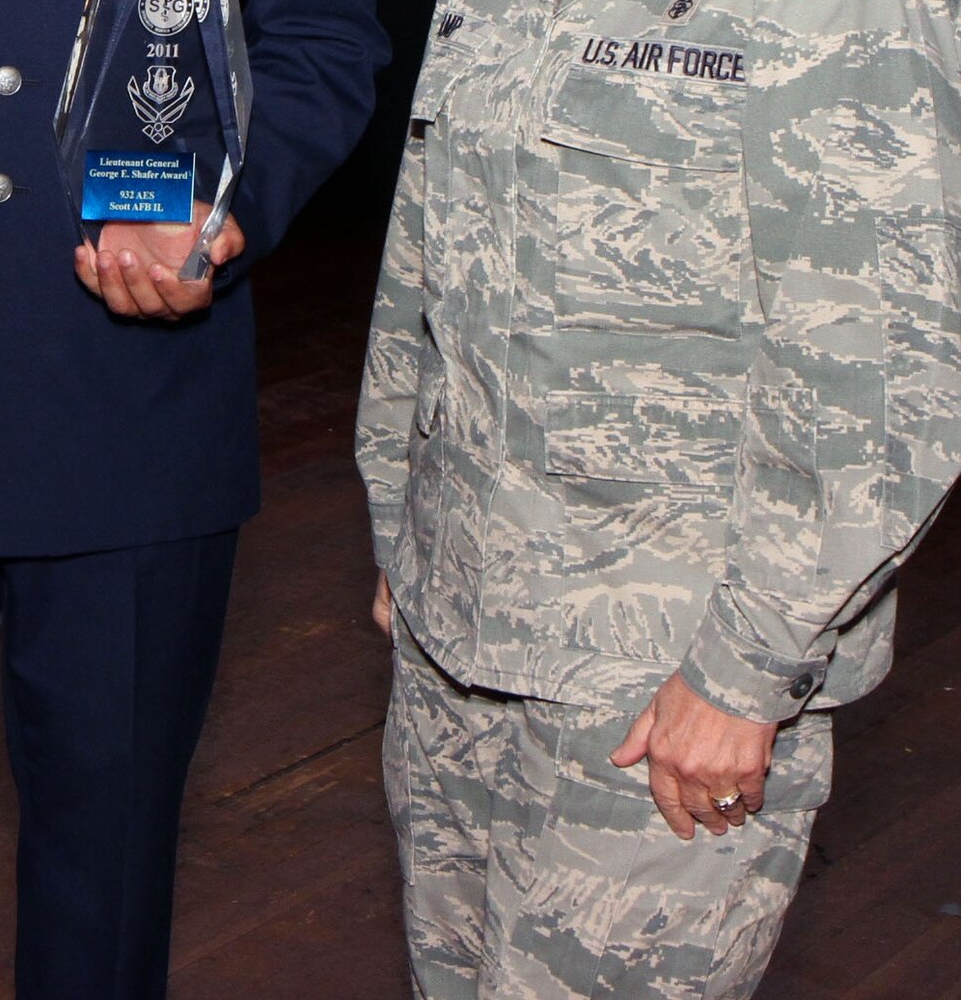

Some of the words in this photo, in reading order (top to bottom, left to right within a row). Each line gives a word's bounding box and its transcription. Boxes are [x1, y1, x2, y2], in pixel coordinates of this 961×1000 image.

[146, 43, 179, 58] 2011
[582, 38, 619, 67] U.S.
[621, 42, 664, 72] AIR
[667, 45, 746, 82] FORCE
[99, 157, 144, 167] Lieutenant
[145, 158, 179, 168] General
[89, 168, 119, 179] George
[121, 169, 130, 178] E.
[131, 170, 159, 179] Shafer
[160, 171, 188, 180] Award
[119, 190, 135, 199] 932
[135, 191, 155, 200] AES
[109, 201, 131, 211] Scott
[131, 202, 151, 212] AFB
[153, 203, 164, 212] IL
